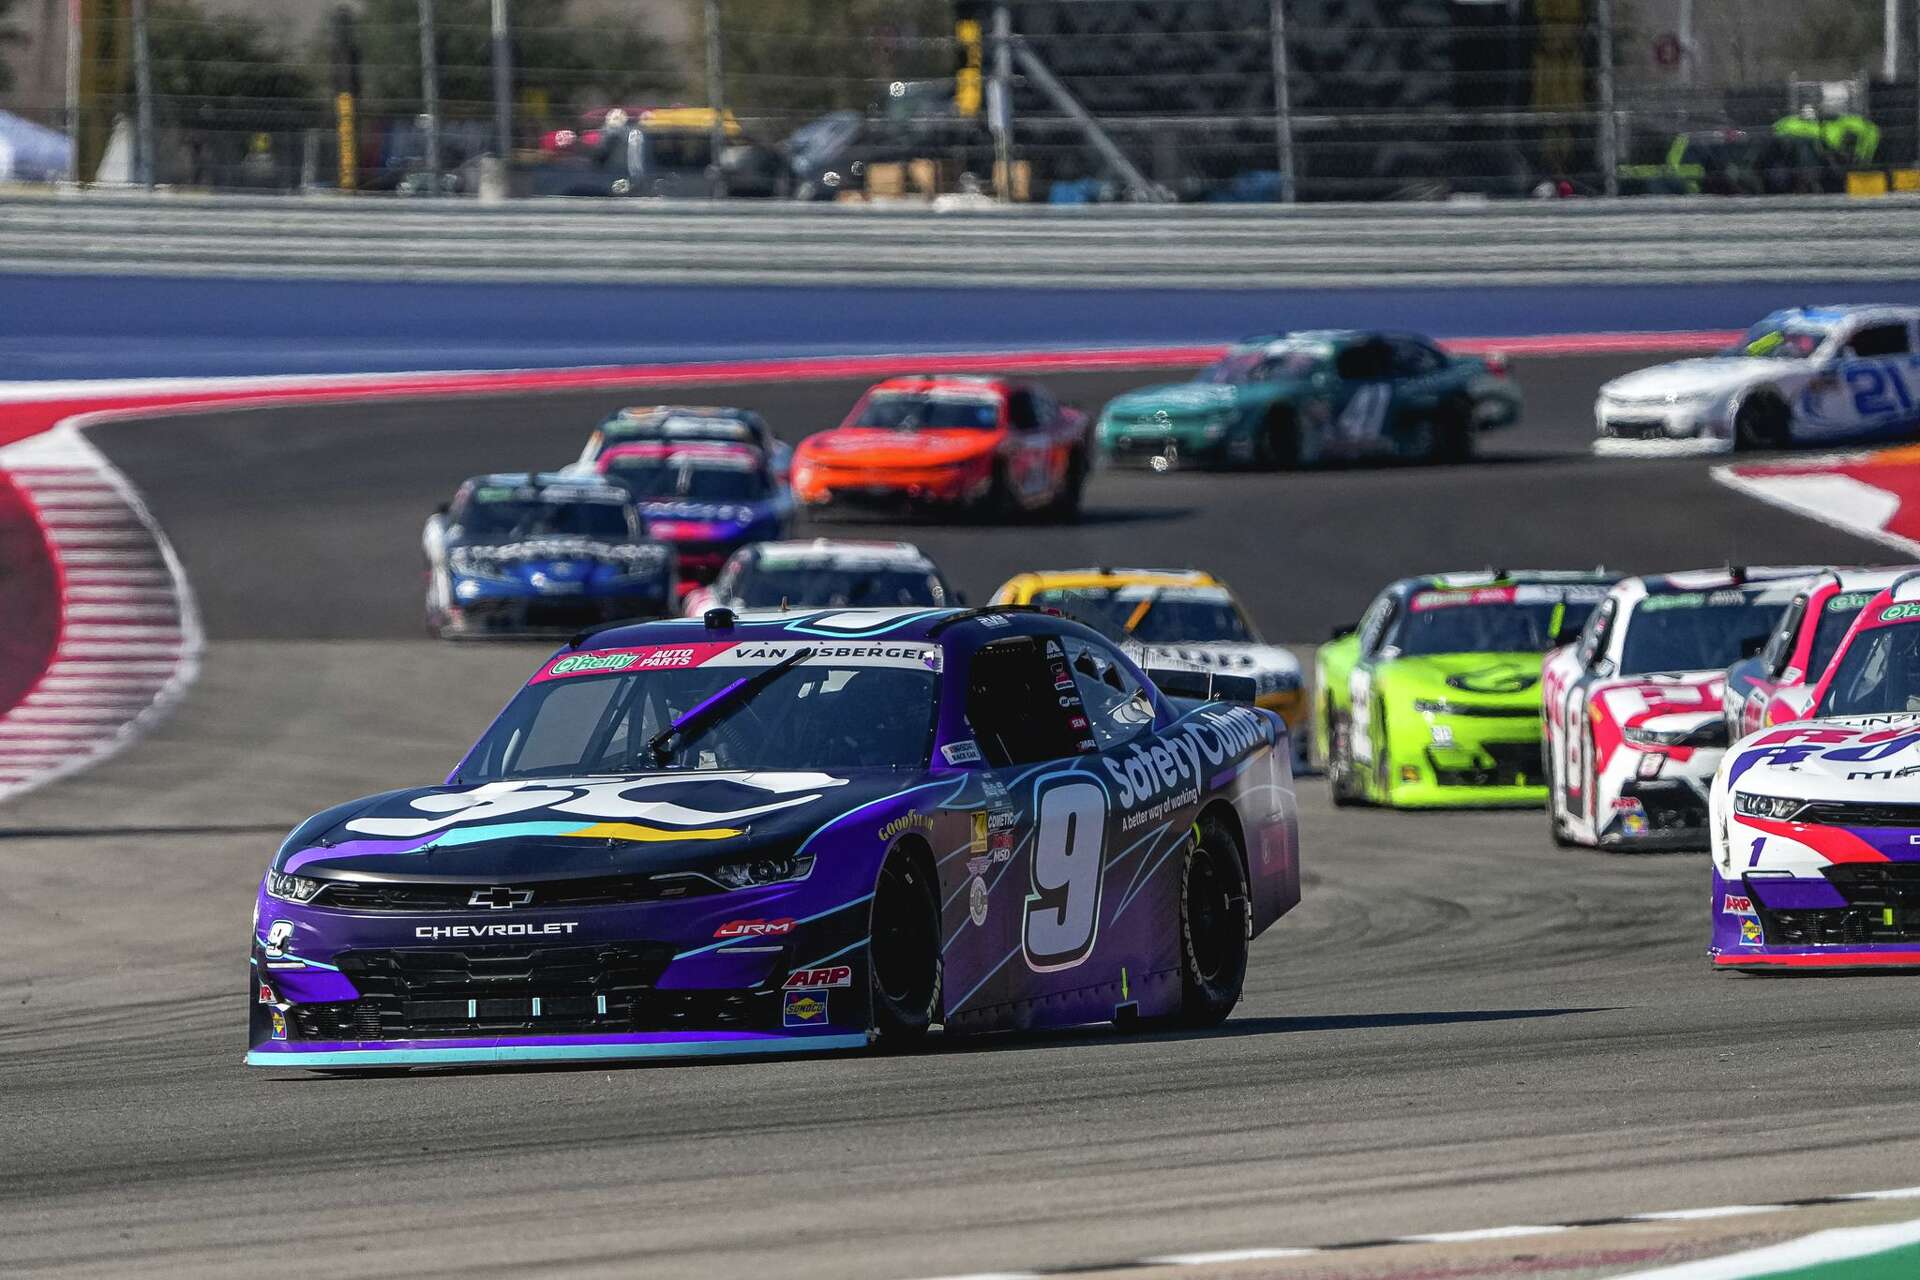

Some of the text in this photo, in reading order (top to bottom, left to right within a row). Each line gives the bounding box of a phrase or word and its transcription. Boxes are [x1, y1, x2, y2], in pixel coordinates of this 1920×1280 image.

[640, 656, 692, 667] PARTS
[650, 649, 694, 659] AUTO
[735, 647, 934, 661] VAN ISBERGE
[551, 653, 640, 674] O'Reilly
[1122, 788, 1198, 832] A better way of working
[1748, 837, 1767, 867] 1
[1024, 775, 1108, 964] 9
[1726, 896, 1752, 911] ARP
[416, 922, 579, 939] CHEVROLET
[720, 923, 789, 935] JRM
[266, 920, 294, 959] 9
[784, 968, 849, 987] ARP
[785, 1002, 826, 1015] SUNOCO
